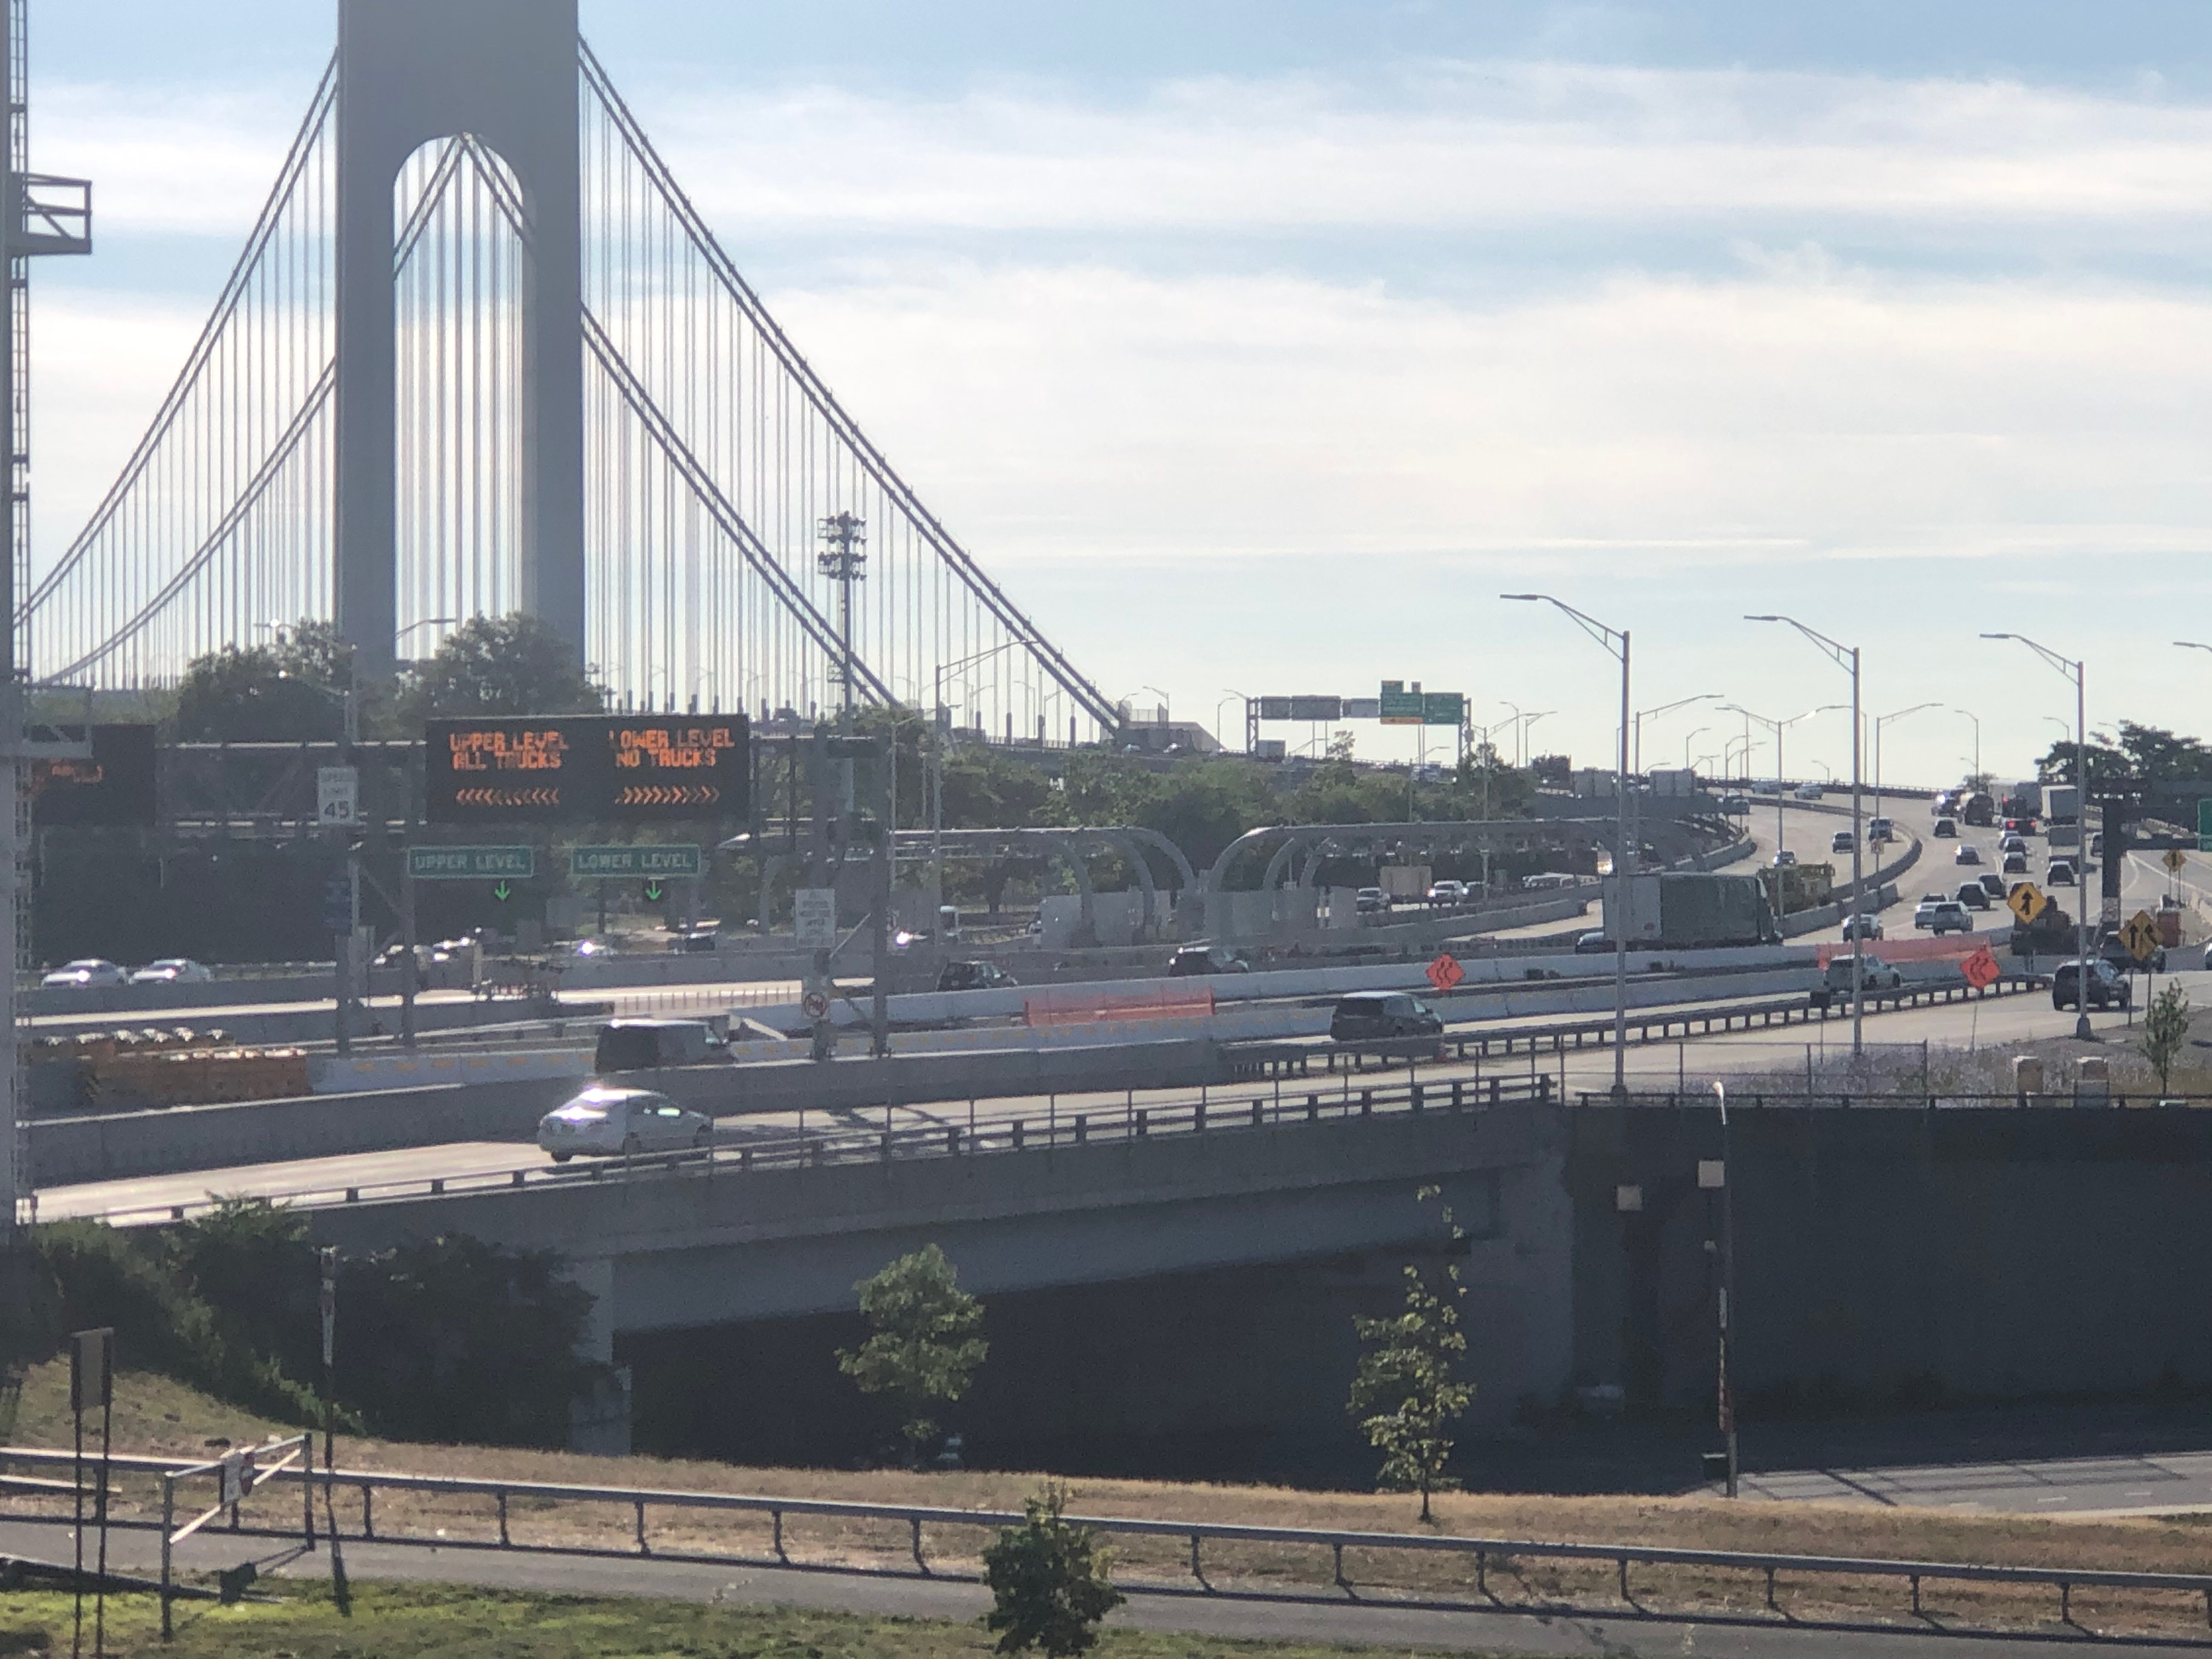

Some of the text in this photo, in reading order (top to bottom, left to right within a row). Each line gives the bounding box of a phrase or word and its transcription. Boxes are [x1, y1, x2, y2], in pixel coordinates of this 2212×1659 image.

[449, 730, 569, 751] UPPER LEVEL
[676, 728, 735, 747] LEVEL
[324, 800, 349, 819] 45
[415, 855, 525, 870] UPPER LEVEL
[578, 853, 692, 868] LOWER LEVEL
